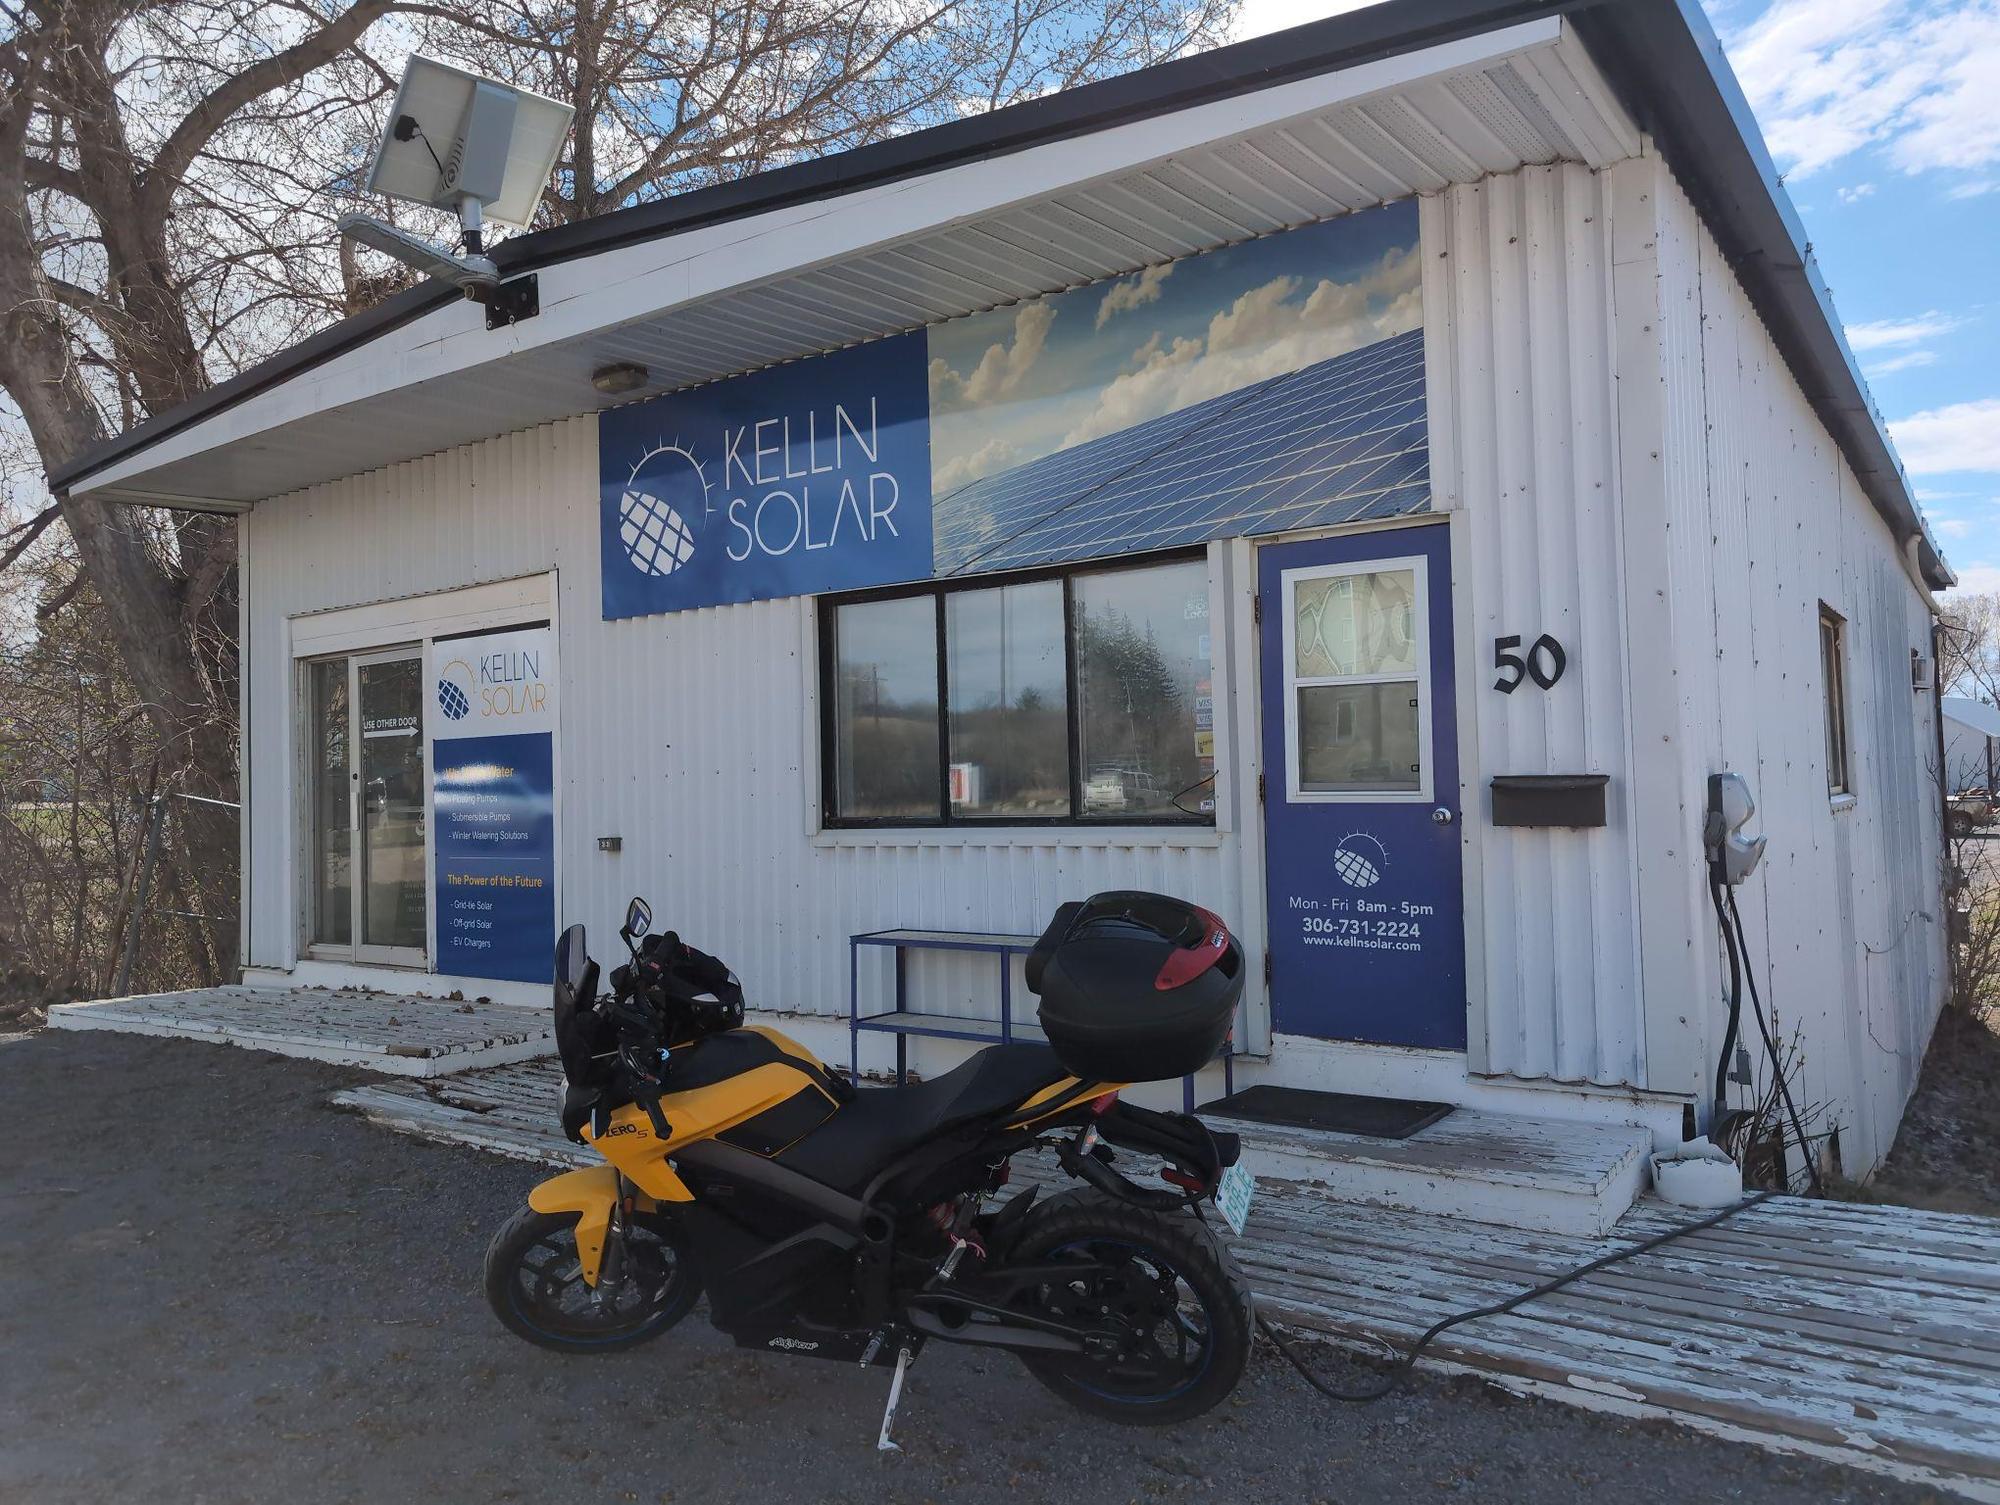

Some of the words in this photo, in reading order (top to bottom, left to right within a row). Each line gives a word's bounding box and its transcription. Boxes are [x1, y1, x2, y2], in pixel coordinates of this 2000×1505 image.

[725, 396, 878, 490] KELLN
[726, 472, 899, 561] SOLAR
[480, 650, 540, 684] KELLN
[1494, 633, 1566, 695] 50
[481, 684, 546, 717] SOLAR
[1198, 698, 1213, 707] VIS
[363, 718, 375, 730] USE
[376, 716, 398, 728] OTHER
[398, 716, 418, 727] DOOR
[452, 812, 488, 822] Submersible
[489, 811, 511, 822] Pumps
[452, 831, 472, 840] Winter
[472, 831, 499, 842] Watering
[500, 830, 529, 841] Solutions
[448, 874, 462, 885] The
[463, 874, 488, 886] Power
[490, 875, 499, 886] of
[500, 875, 513, 887] the
[515, 875, 543, 888] Future
[454, 899, 475, 911] Grid-tie
[476, 900, 493, 911] Solar
[1289, 896, 1319, 910] Mon
[1331, 898, 1349, 911] Fri
[1356, 899, 1387, 913] 8am
[1401, 901, 1434, 918] 5pm
[453, 918, 476, 930] Off-grid
[477, 919, 493, 929] Solar
[1302, 917, 1421, 938] 306-731-2224
[453, 936, 464, 946] EV
[464, 937, 491, 949] Chargers
[1303, 935, 1421, 952] www.kellnsolar.com
